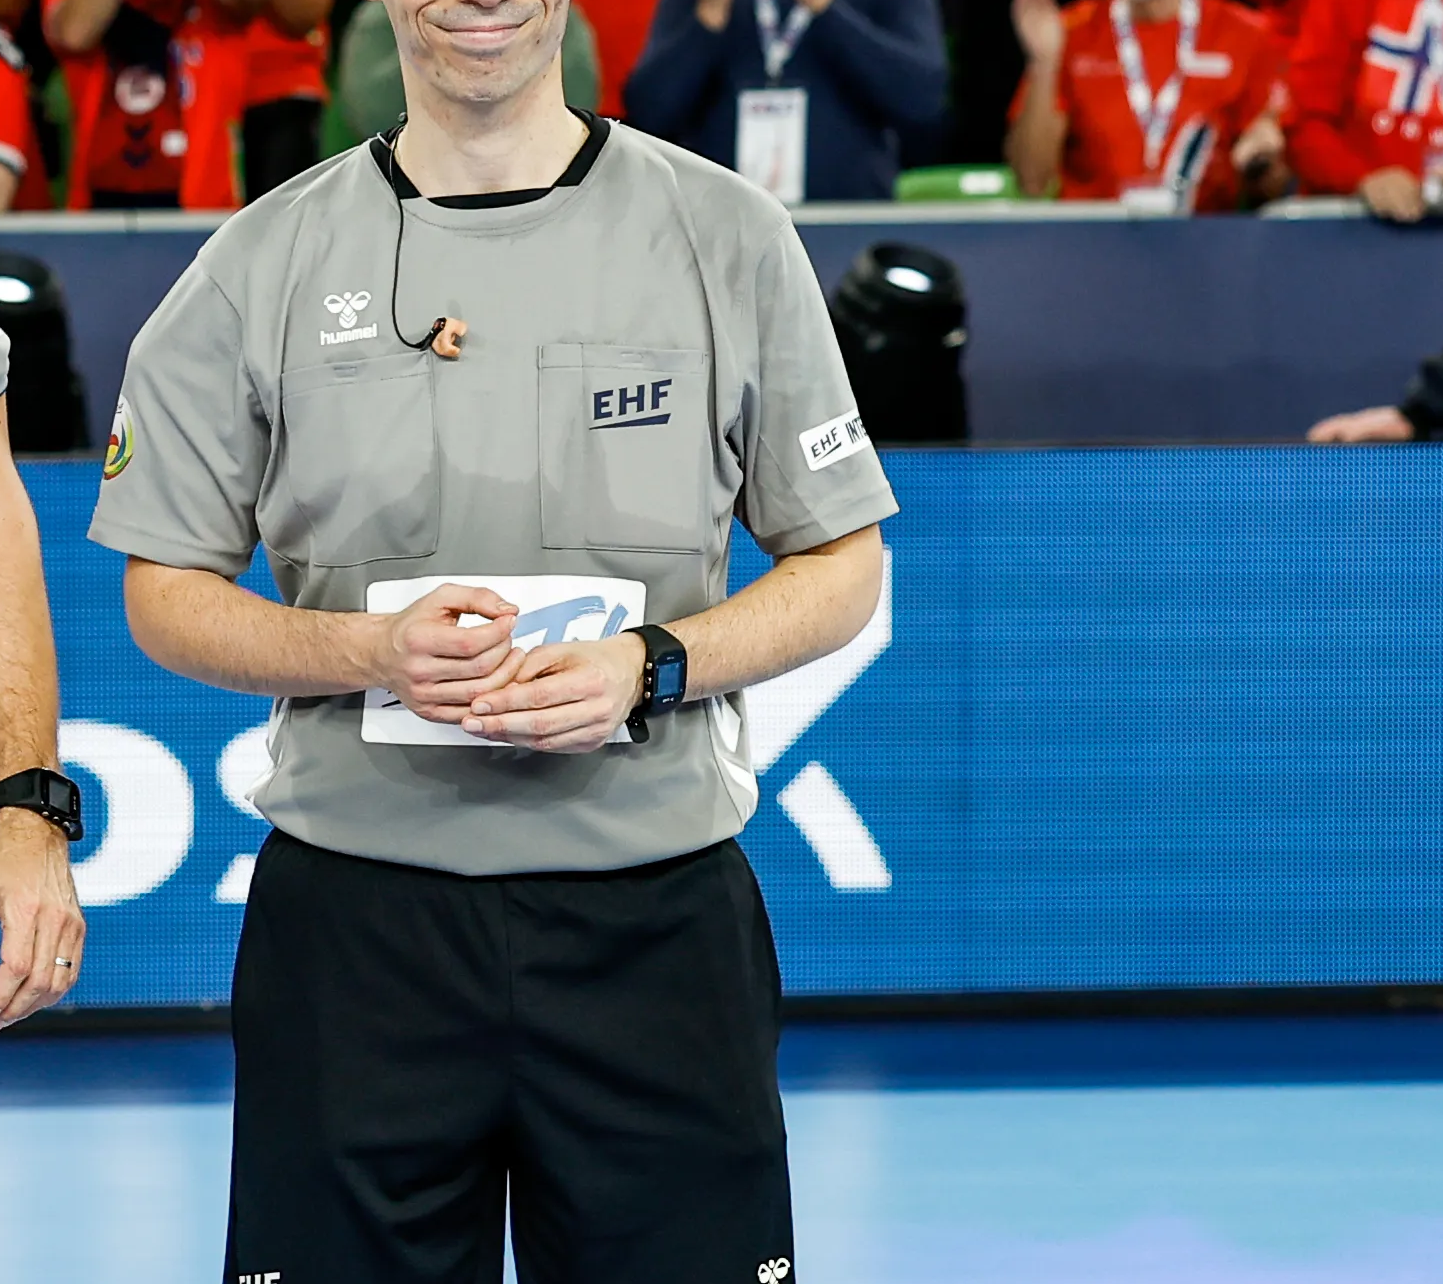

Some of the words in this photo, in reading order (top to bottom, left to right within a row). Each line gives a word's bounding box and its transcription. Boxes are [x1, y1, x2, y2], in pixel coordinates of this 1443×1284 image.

[320, 322, 378, 345] hummel
[593, 378, 673, 420] EHF
[810, 426, 838, 458] EHF
